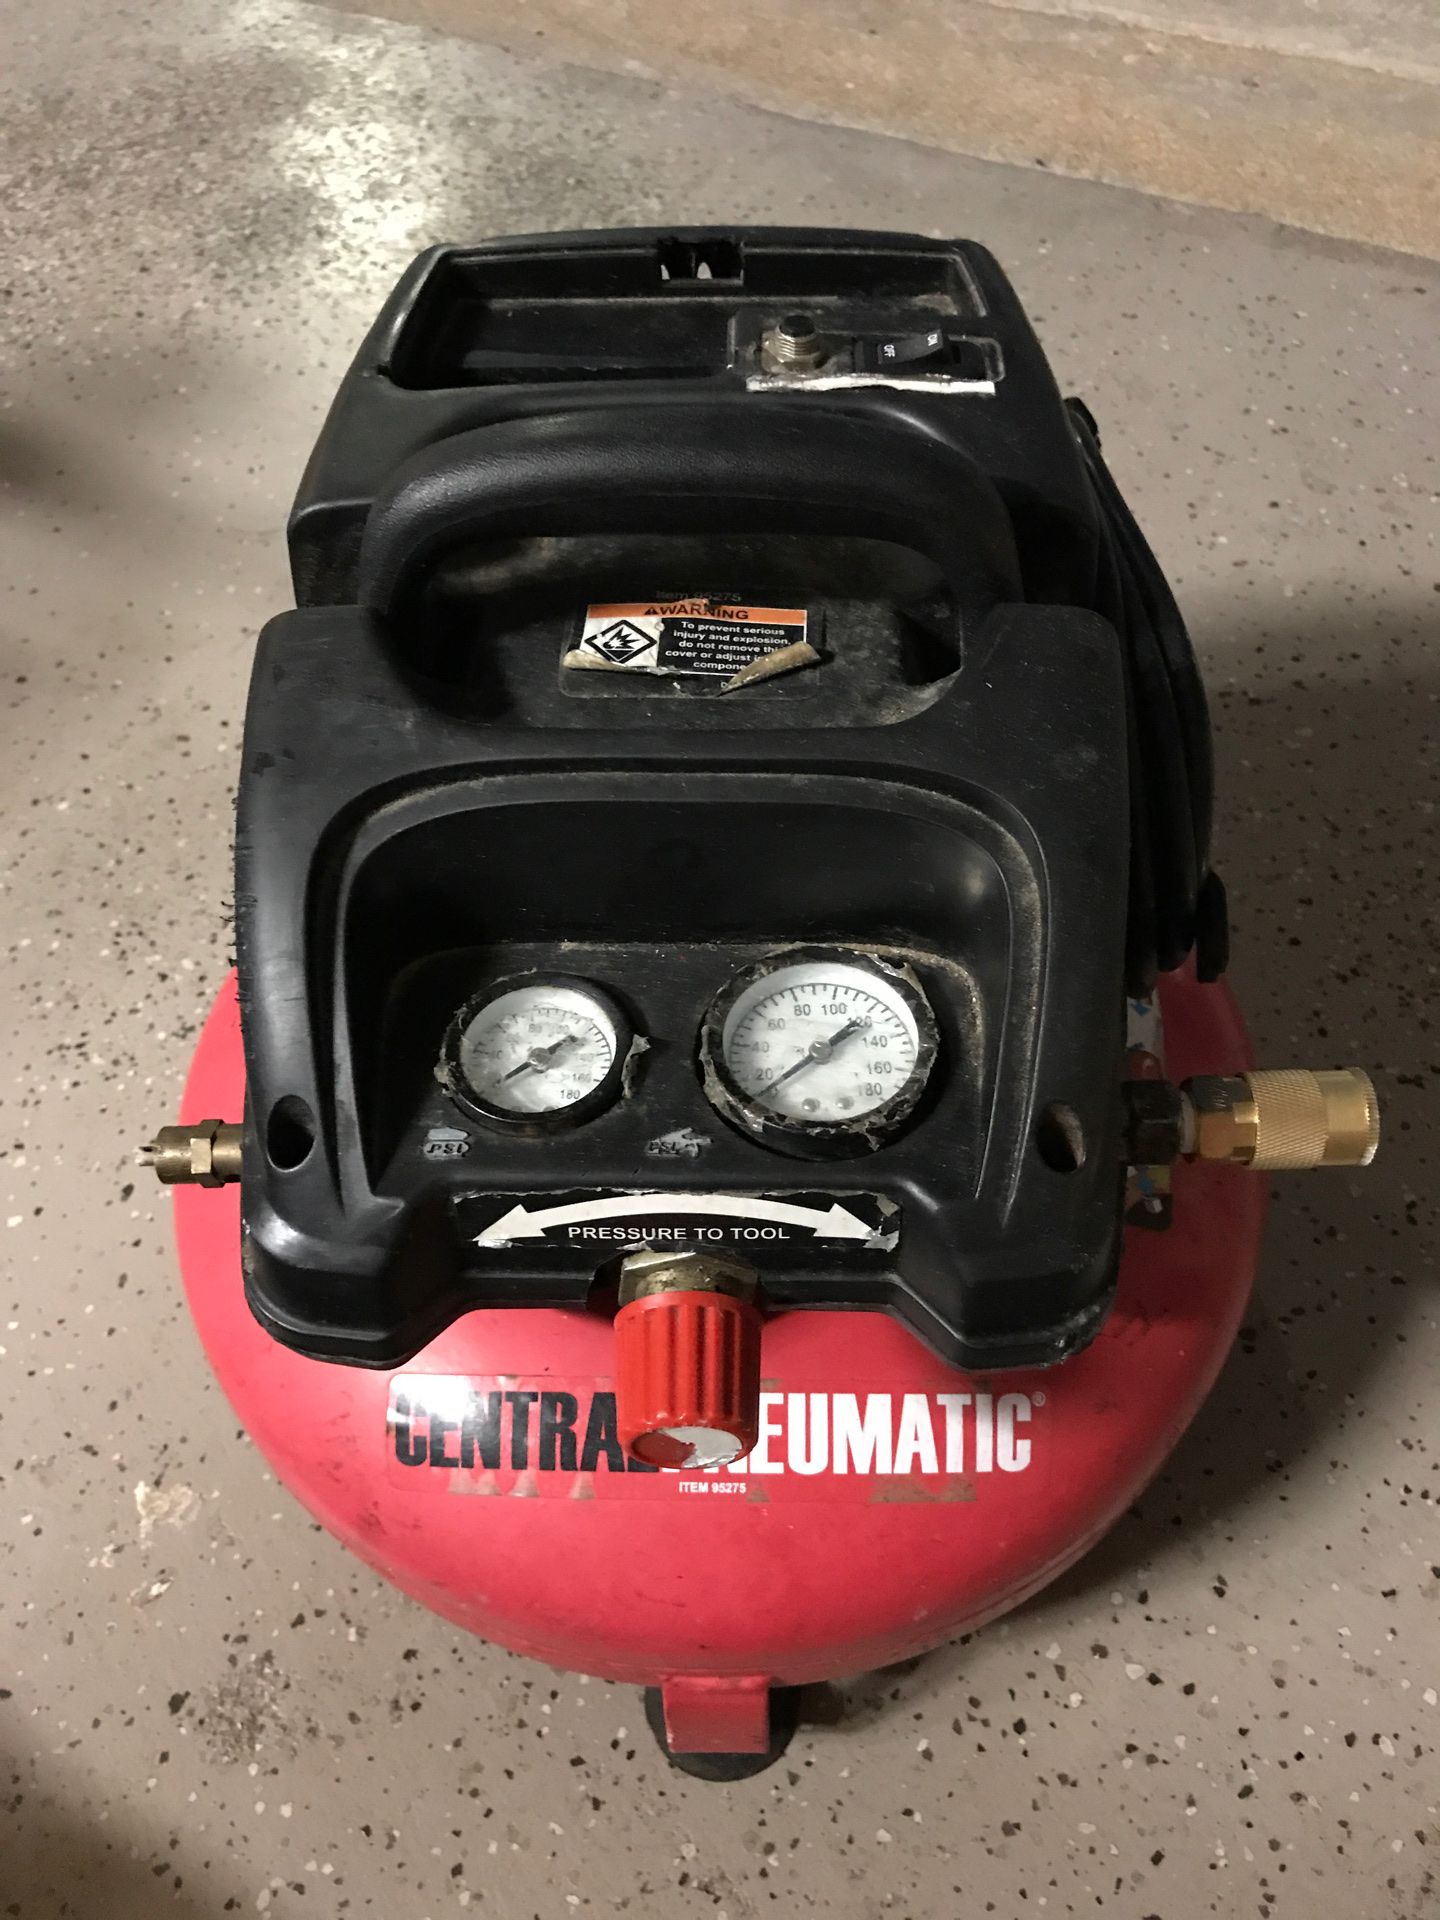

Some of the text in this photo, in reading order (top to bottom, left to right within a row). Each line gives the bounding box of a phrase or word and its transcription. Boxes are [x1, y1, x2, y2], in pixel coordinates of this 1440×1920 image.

[660, 603, 749, 620] WARNING
[681, 621, 785, 636] To prevent serious
[673, 630, 705, 640] injury
[708, 633, 730, 641] and
[678, 640, 694, 648] do
[696, 642, 715, 650] not
[718, 643, 760, 653] remove
[665, 650, 697, 658] cover
[700, 651, 713, 659] or
[715, 653, 751, 662] adjust
[793, 1004, 811, 1017] 80
[821, 1002, 847, 1015] 100
[768, 1017, 786, 1031] 60
[862, 1035, 888, 1048] 140
[867, 1061, 892, 1074] 160
[756, 1068, 774, 1081] 20
[560, 1089, 581, 1100] 180
[427, 1143, 463, 1154] PSI
[568, 1227, 791, 1240] PRESSURE TO TOOL
[395, 1391, 1032, 1475] CENTRA EUMATIC
[678, 1482, 747, 1494] ITEM 95275
